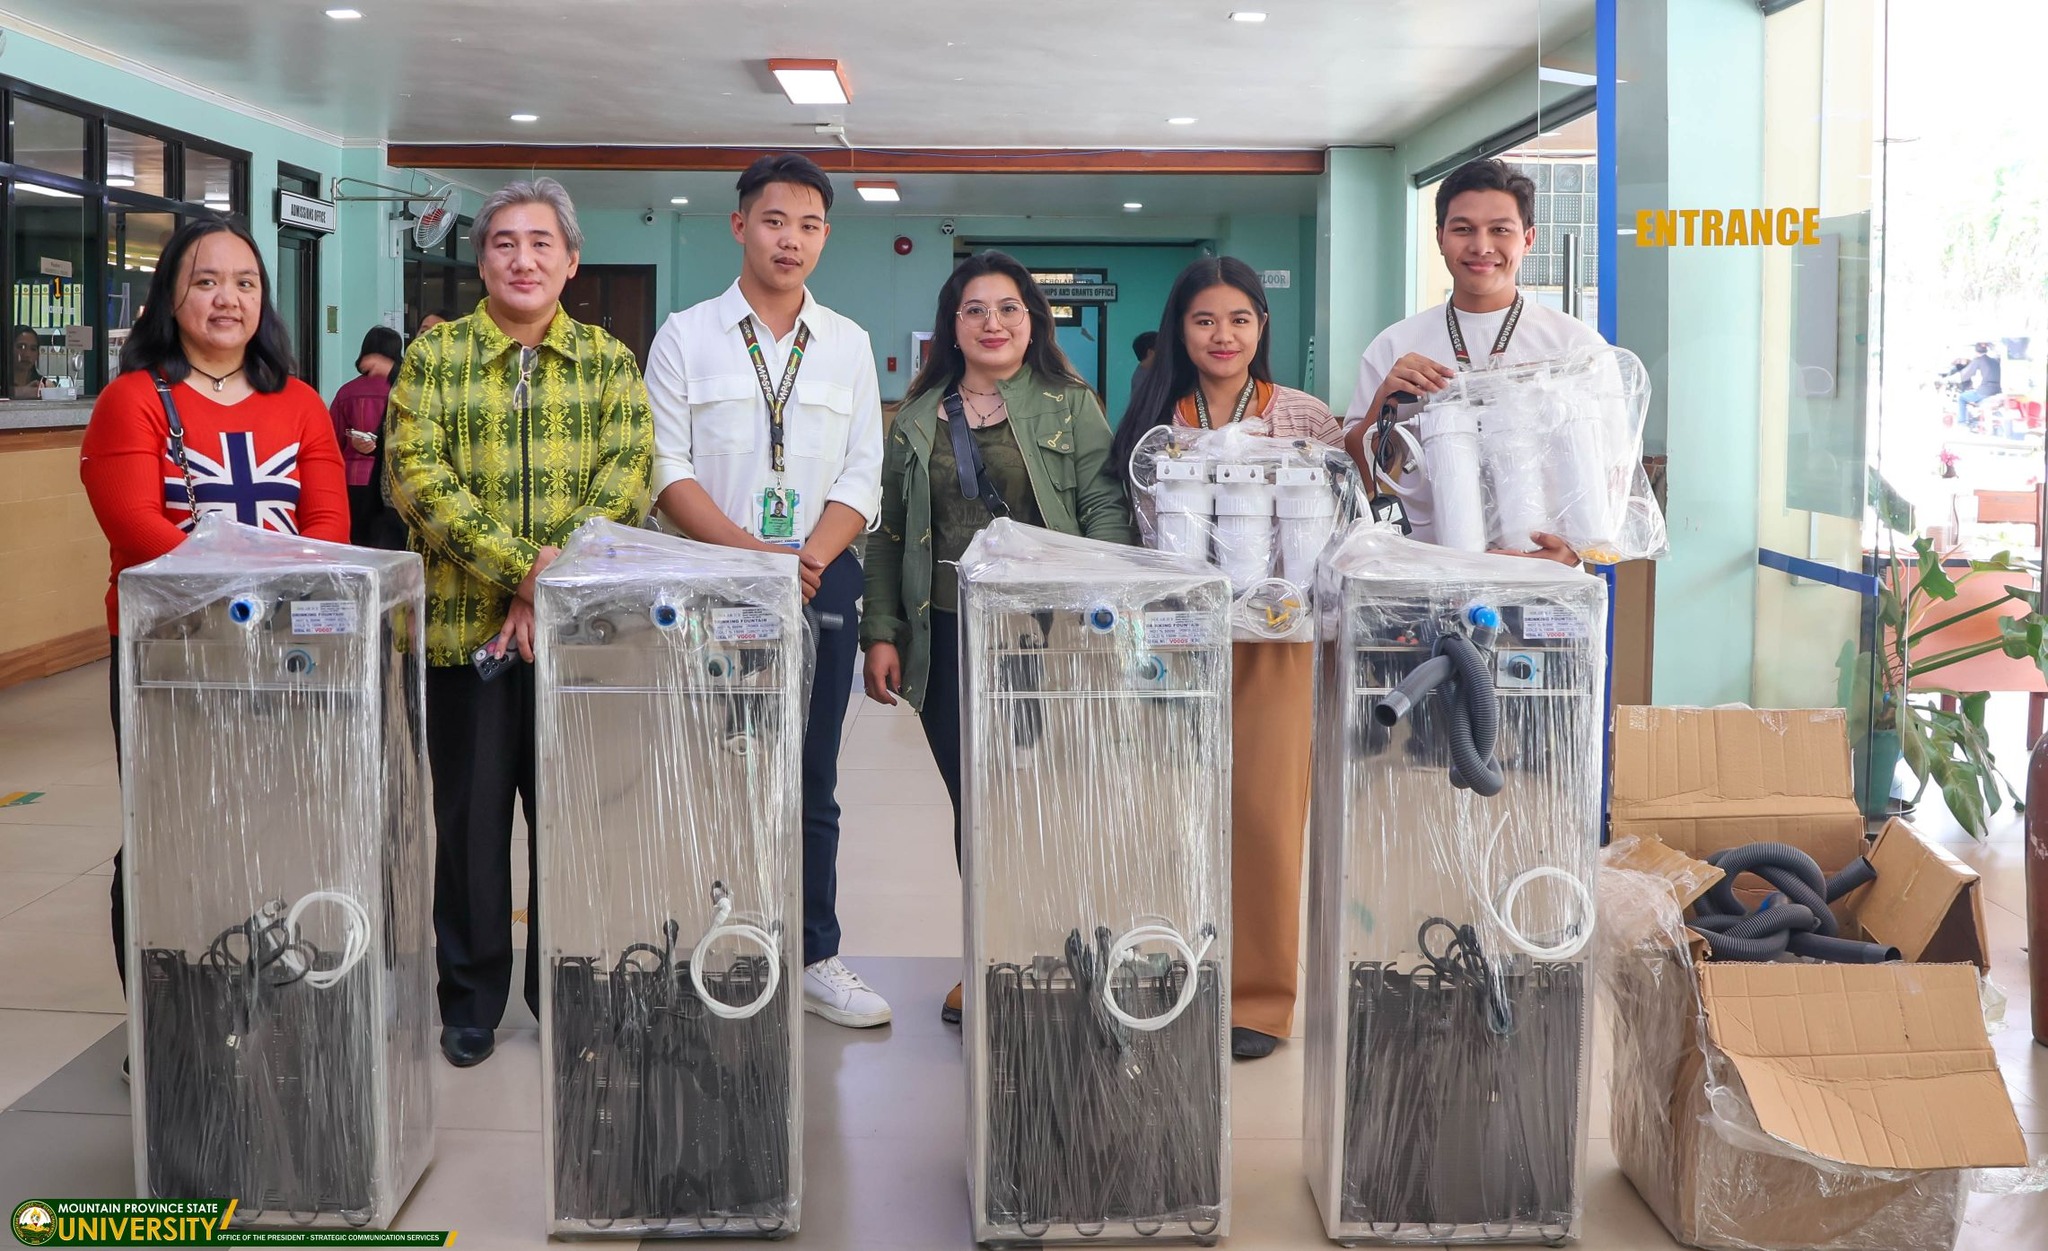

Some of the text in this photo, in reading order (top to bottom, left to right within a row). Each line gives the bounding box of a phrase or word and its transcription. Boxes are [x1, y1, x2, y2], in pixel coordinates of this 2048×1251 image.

[1636, 207, 1821, 247] ENTRANCE
[1058, 288, 1070, 297] AND
[1071, 288, 1093, 297] GRANTS
[1094, 288, 1115, 297] OFFICE
[756, 364, 775, 402] MPSPC
[778, 366, 796, 403] MPSPC
